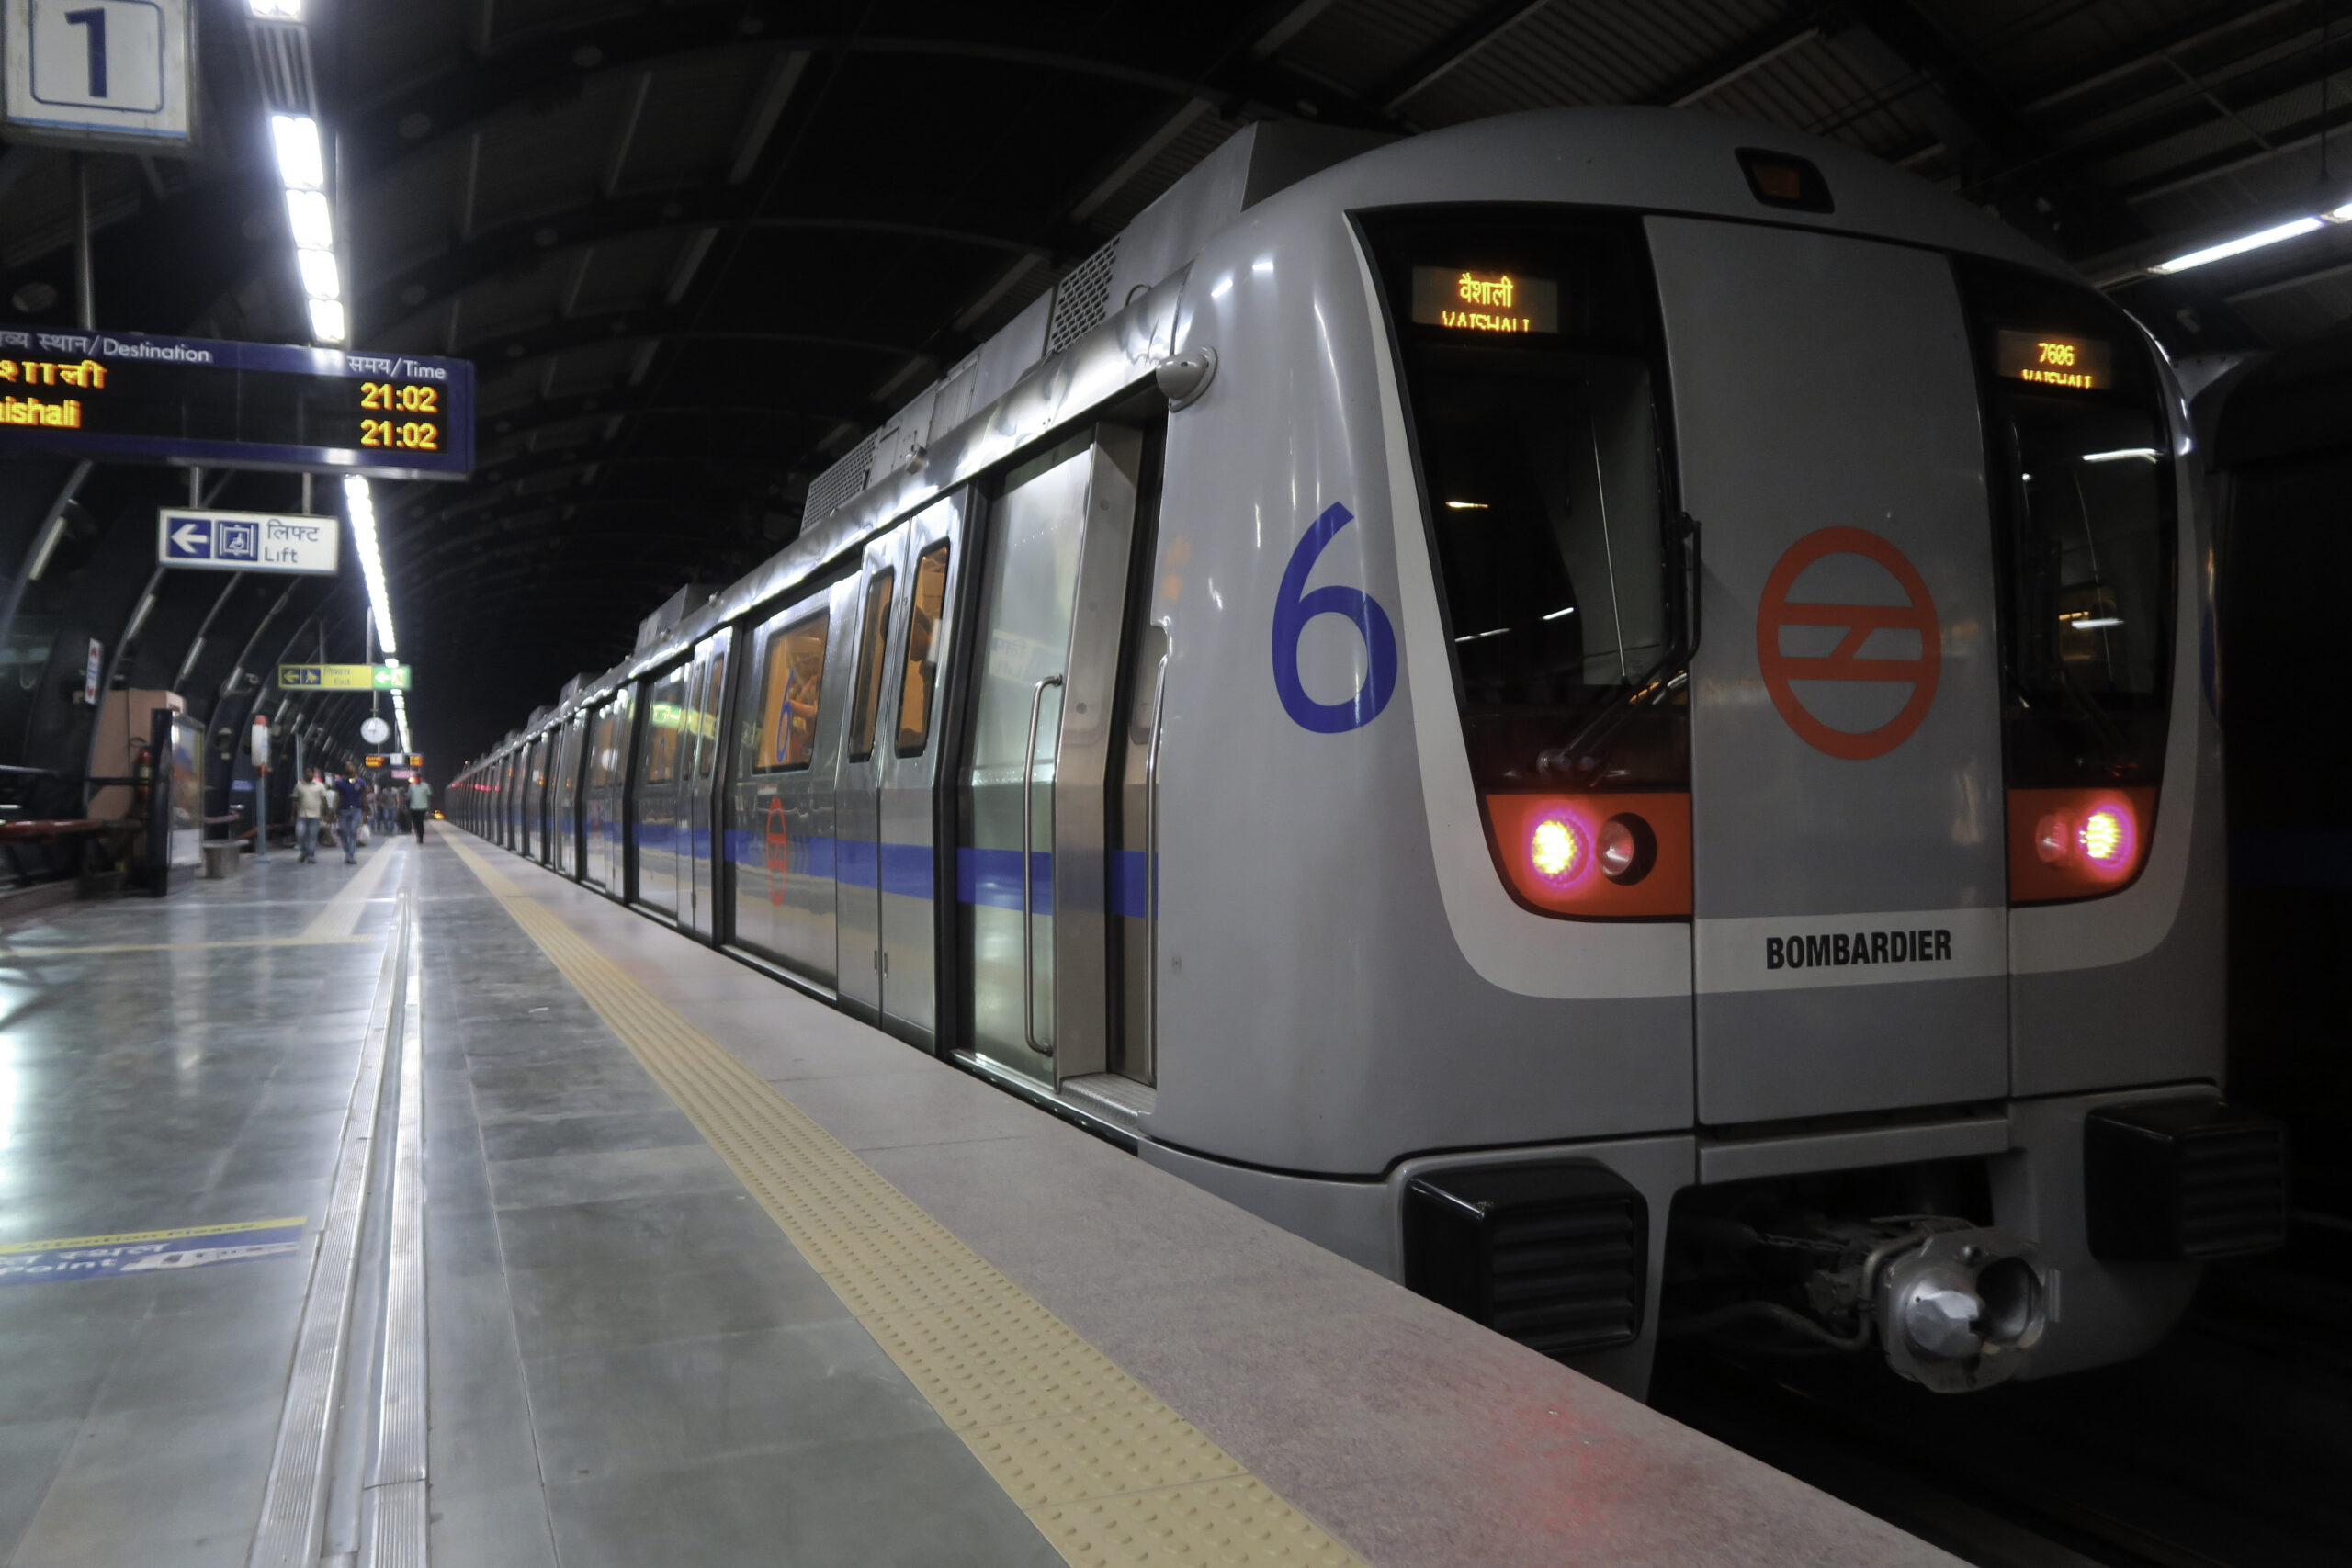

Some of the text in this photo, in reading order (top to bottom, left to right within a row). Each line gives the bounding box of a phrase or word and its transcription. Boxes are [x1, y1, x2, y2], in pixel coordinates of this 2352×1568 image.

[65, 8, 107, 98] 1
[1459, 272, 1514, 308] वैशाली
[360, 381, 438, 413] 21:02
[360, 419, 438, 450] 21:02
[267, 518, 320, 542] लिफ्ट
[264, 547, 298, 563] Lift
[1272, 501, 1398, 734] 6
[1766, 929, 1951, 970] BOMBARDIER
